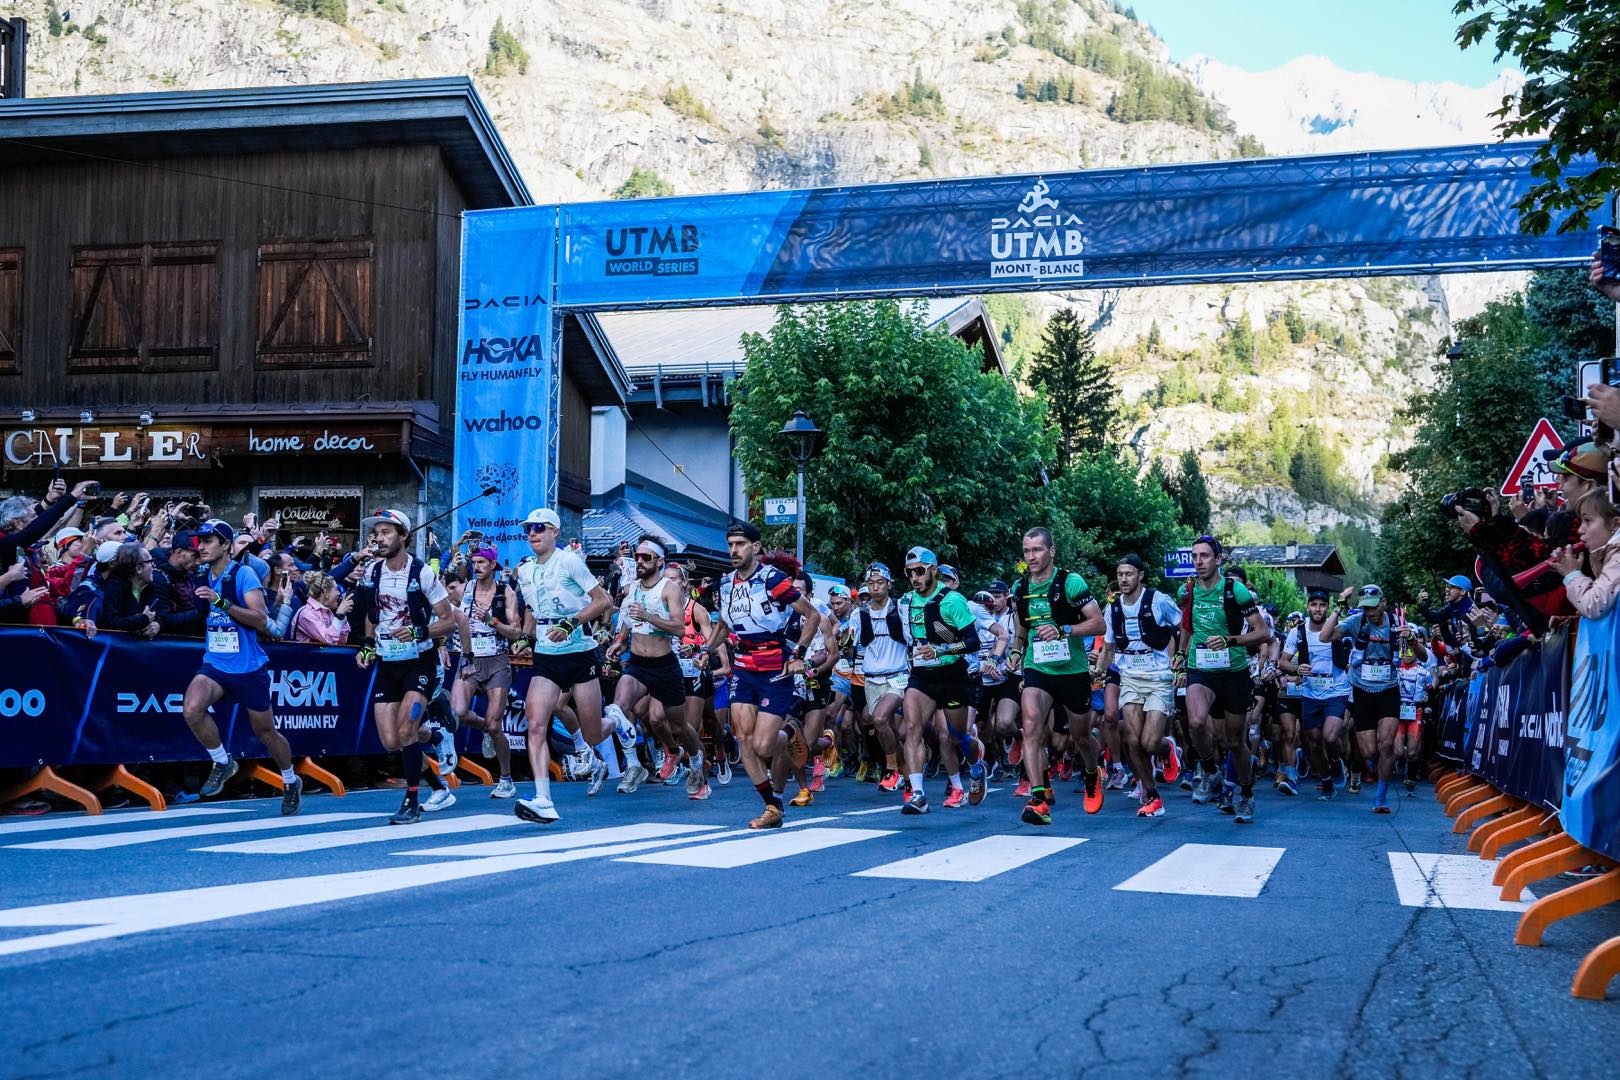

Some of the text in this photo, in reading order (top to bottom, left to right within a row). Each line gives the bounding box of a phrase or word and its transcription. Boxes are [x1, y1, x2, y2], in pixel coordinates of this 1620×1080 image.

[991, 213, 1084, 230] DACIA
[605, 223, 700, 257] UTMB
[991, 229, 1084, 259] UTMB
[609, 261, 696, 274] WORLD SERIES
[464, 294, 548, 310] DACIA
[461, 334, 544, 365] HOKA
[461, 367, 543, 381] FLY HUMAN FLY
[463, 410, 542, 433] wahoo
[249, 427, 375, 452] home decor
[282, 505, 330, 520] Catelier
[1041, 644, 1059, 652] 3002
[268, 670, 339, 707] HOKA
[284, 715, 321, 729] HUMAN
[322, 715, 339, 729] FLY
